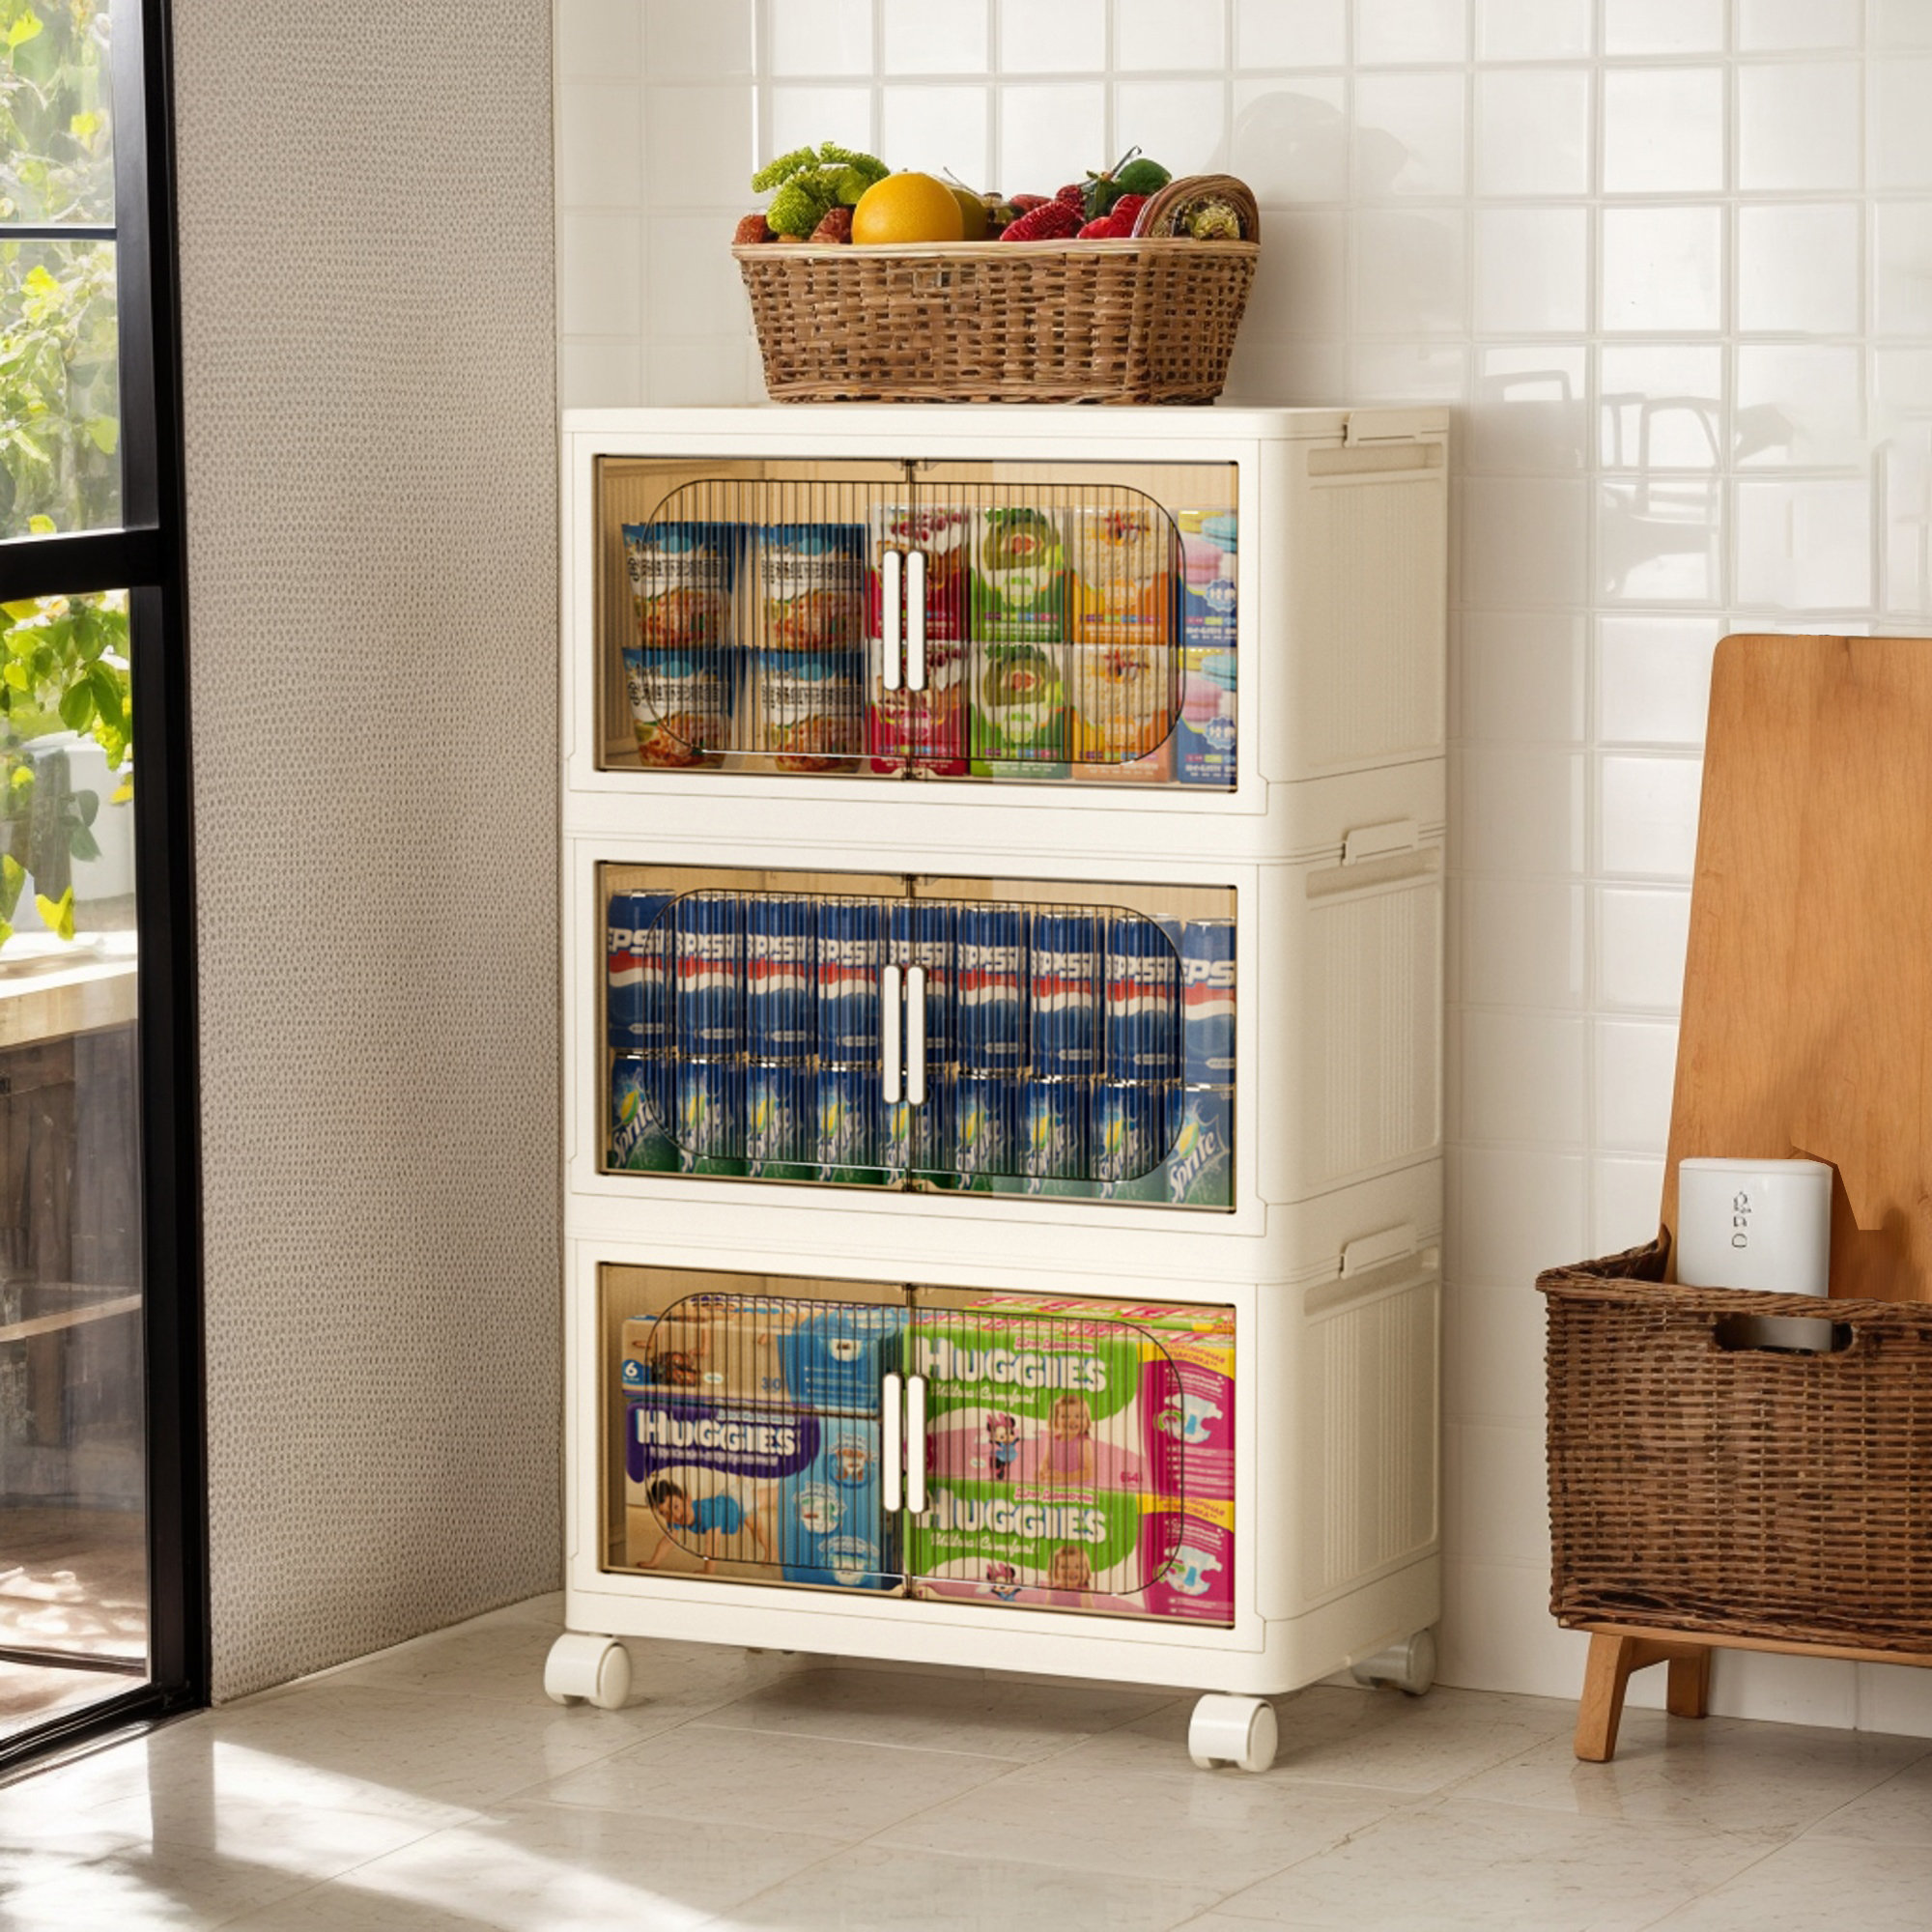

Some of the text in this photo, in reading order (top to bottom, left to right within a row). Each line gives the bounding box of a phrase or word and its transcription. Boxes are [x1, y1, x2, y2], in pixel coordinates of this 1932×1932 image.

[1170, 1130, 1215, 1204] Sprite
[625, 1362, 638, 1377] 6
[913, 1336, 1106, 1392] HUGGIES
[636, 1408, 795, 1456] HUGGIES
[915, 1487, 1106, 1544] HUGGIES
